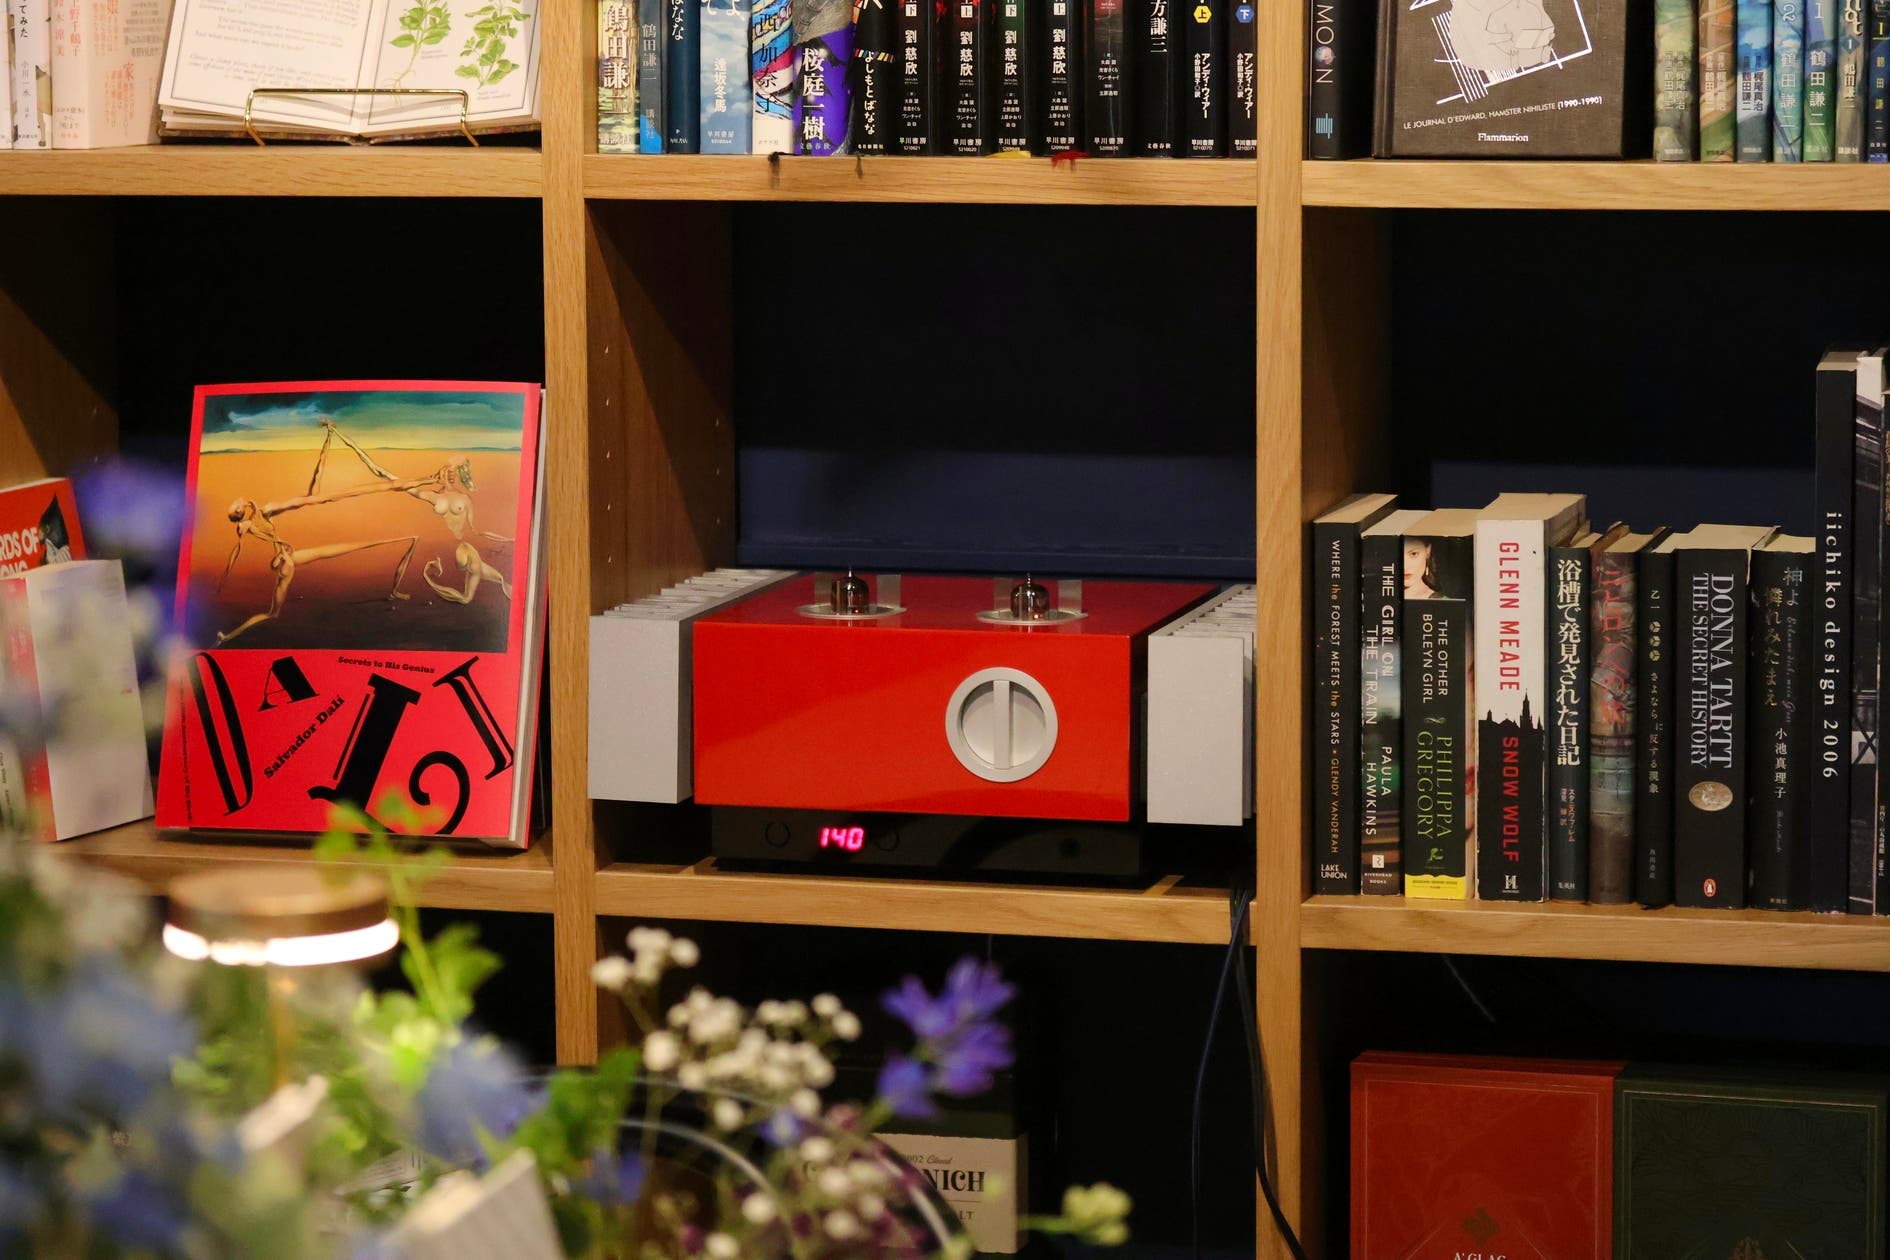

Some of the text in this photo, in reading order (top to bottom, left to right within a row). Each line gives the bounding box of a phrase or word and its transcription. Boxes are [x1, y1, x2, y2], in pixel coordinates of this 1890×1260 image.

[18, 0, 28, 38] てみた
[1150, 0, 1168, 53] 方謙三
[1198, 9, 1207, 19] 上
[1240, 9, 1250, 20] 下
[1783, 4, 1796, 21] 2
[1815, 3, 1824, 19] 1
[603, 4, 630, 114] 鶴田謙二
[642, 24, 656, 80] 鶴田謙二
[758, 14, 777, 112] 西加奈子
[904, 30, 918, 75] 劉慈欣
[960, 31, 973, 76] 劉慈欣
[1004, 30, 1017, 76] 劉慈欣
[1053, 29, 1066, 74] 劉慈欣
[714, 58, 728, 112] 逢坂冬馬
[802, 48, 826, 140] 桜庭一樹
[864, 51, 877, 135] よしもとばなな
[1202, 53, 1211, 118] アンディ・ウィアー
[1244, 53, 1254, 118] アンディ・ウィアー
[1403, 96, 1602, 130] LE JOURNAL D'EDWARD, HAMSTER NIHILISTE (1990-1990)
[1742, 72, 1751, 111] 鶴田謙二
[1754, 72, 1763, 111] 梶尾真治
[1780, 52, 1796, 128] 鶴田謙二
[1809, 50, 1826, 126] 鶴田謙二
[1875, 57, 1885, 130] 鶴田謙二
[953, 138, 982, 146] 早川書房
[1478, 132, 1529, 142] Flammarion
[22, 526, 39, 555] OF
[1649, 590, 1660, 610] 乙一
[1783, 566, 1803, 608] 神よ
[1381, 564, 1394, 676] THE GIRL ON
[1499, 542, 1520, 692] GLENN MEADE
[338, 656, 435, 674] Secrets to His Genius
[1422, 614, 1432, 703] BOLEYN GIRL
[1438, 620, 1448, 696] THE OTHER
[1556, 559, 1581, 766] 浴槽で発見された日記
[1690, 573, 1708, 768] THE SECRET HISTORY
[1709, 575, 1734, 769] DONNA TARTT
[1819, 511, 1842, 780] iichiko design 2006
[1331, 540, 1340, 853] WHERE the FOREST MEETS the STARS GLENDY VANDERAH
[1365, 625, 1378, 725] THE TRAIN
[263, 724, 316, 779] Salvador
[1381, 747, 1392, 796] PAULA
[1774, 727, 1788, 798] 小池真理子
[1366, 763, 1376, 836] HAWKINS
[1417, 731, 1432, 840] GREGORY
[1436, 736, 1453, 839] PHILIPPA
[1502, 736, 1519, 863] SNOW WOLF
[820, 828, 864, 849] 140
[1321, 864, 1339, 872] LAKE
